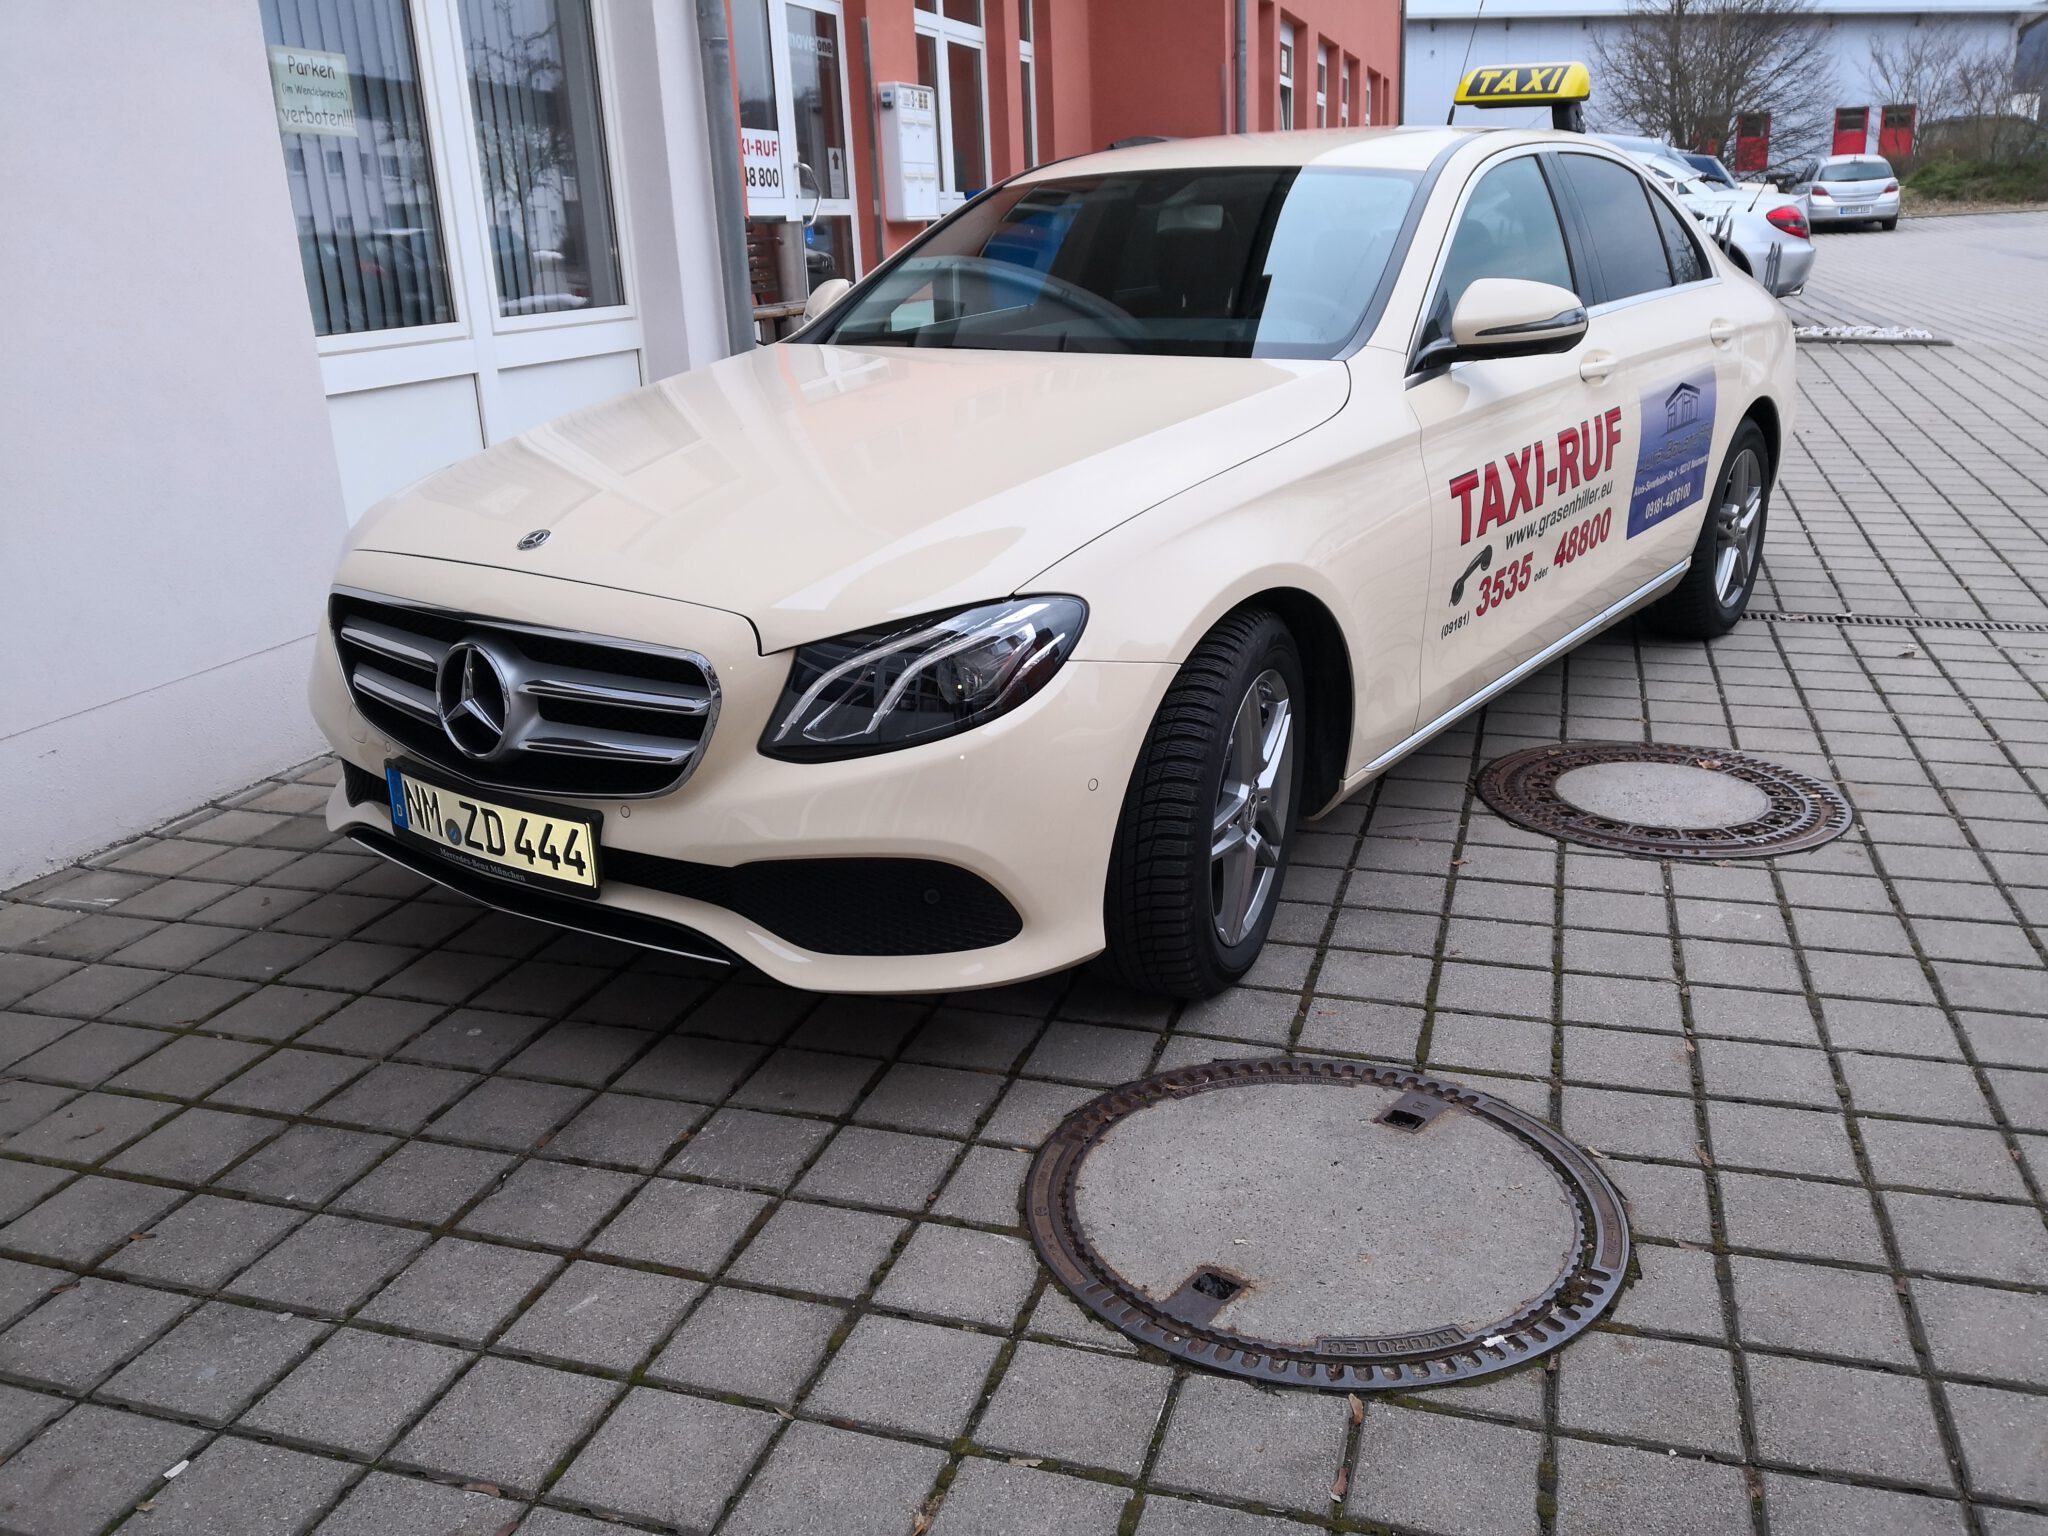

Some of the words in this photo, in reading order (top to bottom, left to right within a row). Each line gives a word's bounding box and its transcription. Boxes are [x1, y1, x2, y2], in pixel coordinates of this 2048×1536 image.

[287, 55, 335, 80] Parken
[1479, 67, 1564, 94] TAXI
[758, 167, 779, 188] 800
[1449, 406, 1622, 546] TAXI-RUF
[1505, 480, 1613, 550] www.grasenhiller.eu
[1440, 611, 1470, 640] (09181)
[1476, 551, 1534, 617] 3535
[1533, 566, 1549, 582] oder
[1553, 507, 1612, 568] 48800
[403, 780, 444, 837] NM
[459, 801, 506, 857] ZD
[514, 818, 587, 876] 444
[440, 847, 489, 871] Mercedes-Benz
[489, 864, 526, 881] München
